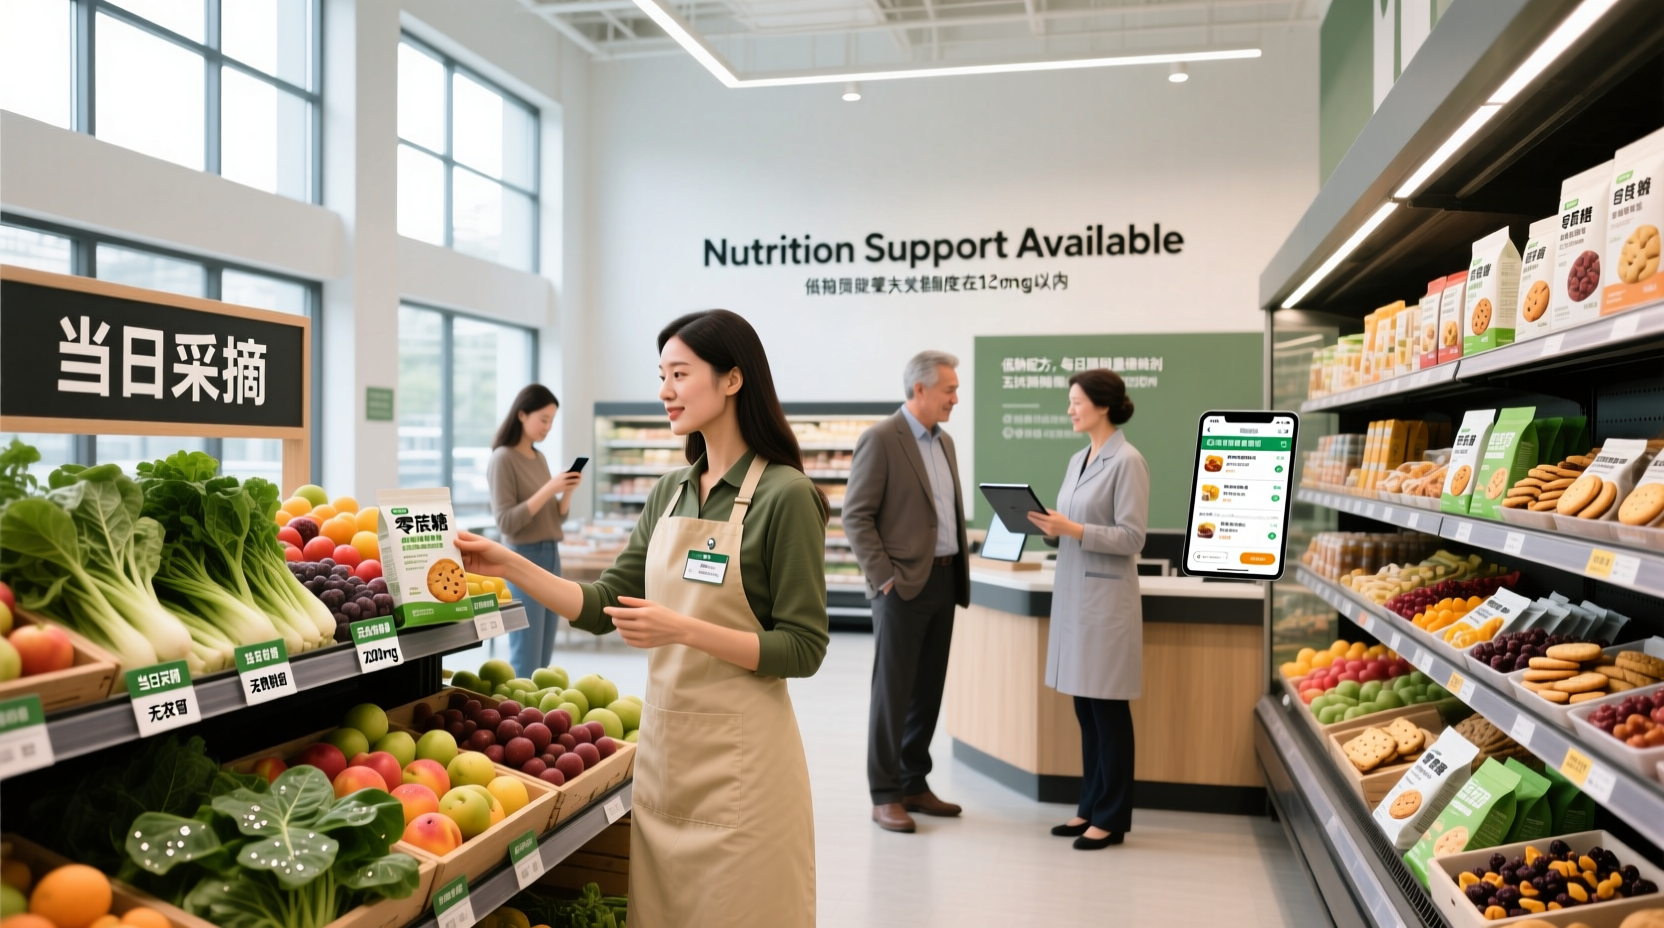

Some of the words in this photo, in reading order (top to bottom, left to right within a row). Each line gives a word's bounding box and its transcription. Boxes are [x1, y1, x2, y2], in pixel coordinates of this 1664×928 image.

[704, 234, 854, 267] Nutrition
[865, 231, 1008, 269] Support
[1016, 223, 1185, 259] Available
[57, 315, 268, 406] 当日采摘
